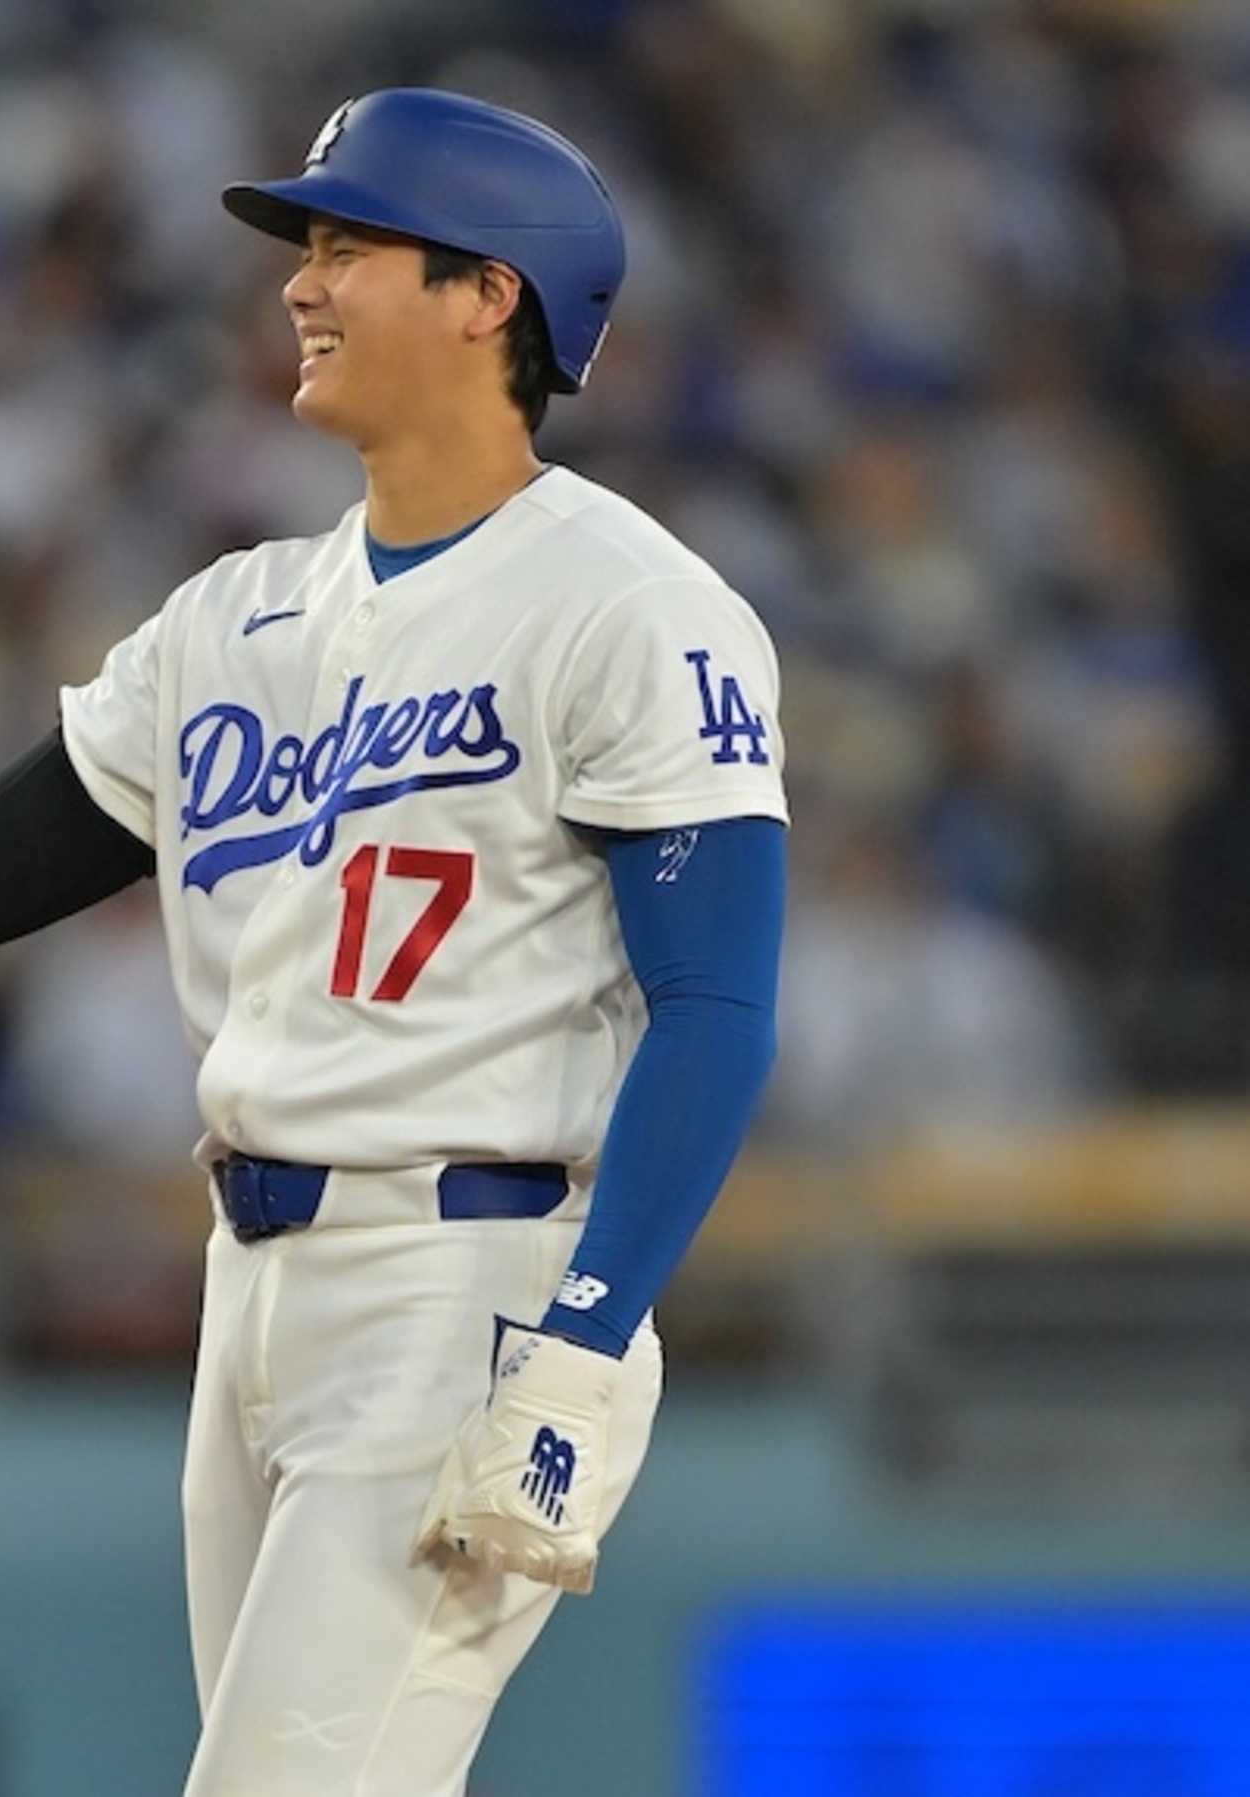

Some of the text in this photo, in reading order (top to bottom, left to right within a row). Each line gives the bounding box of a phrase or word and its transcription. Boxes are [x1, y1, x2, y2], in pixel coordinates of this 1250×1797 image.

[180, 675, 514, 868] Dodgers
[684, 649, 769, 766] LA
[330, 844, 474, 1003] 17
